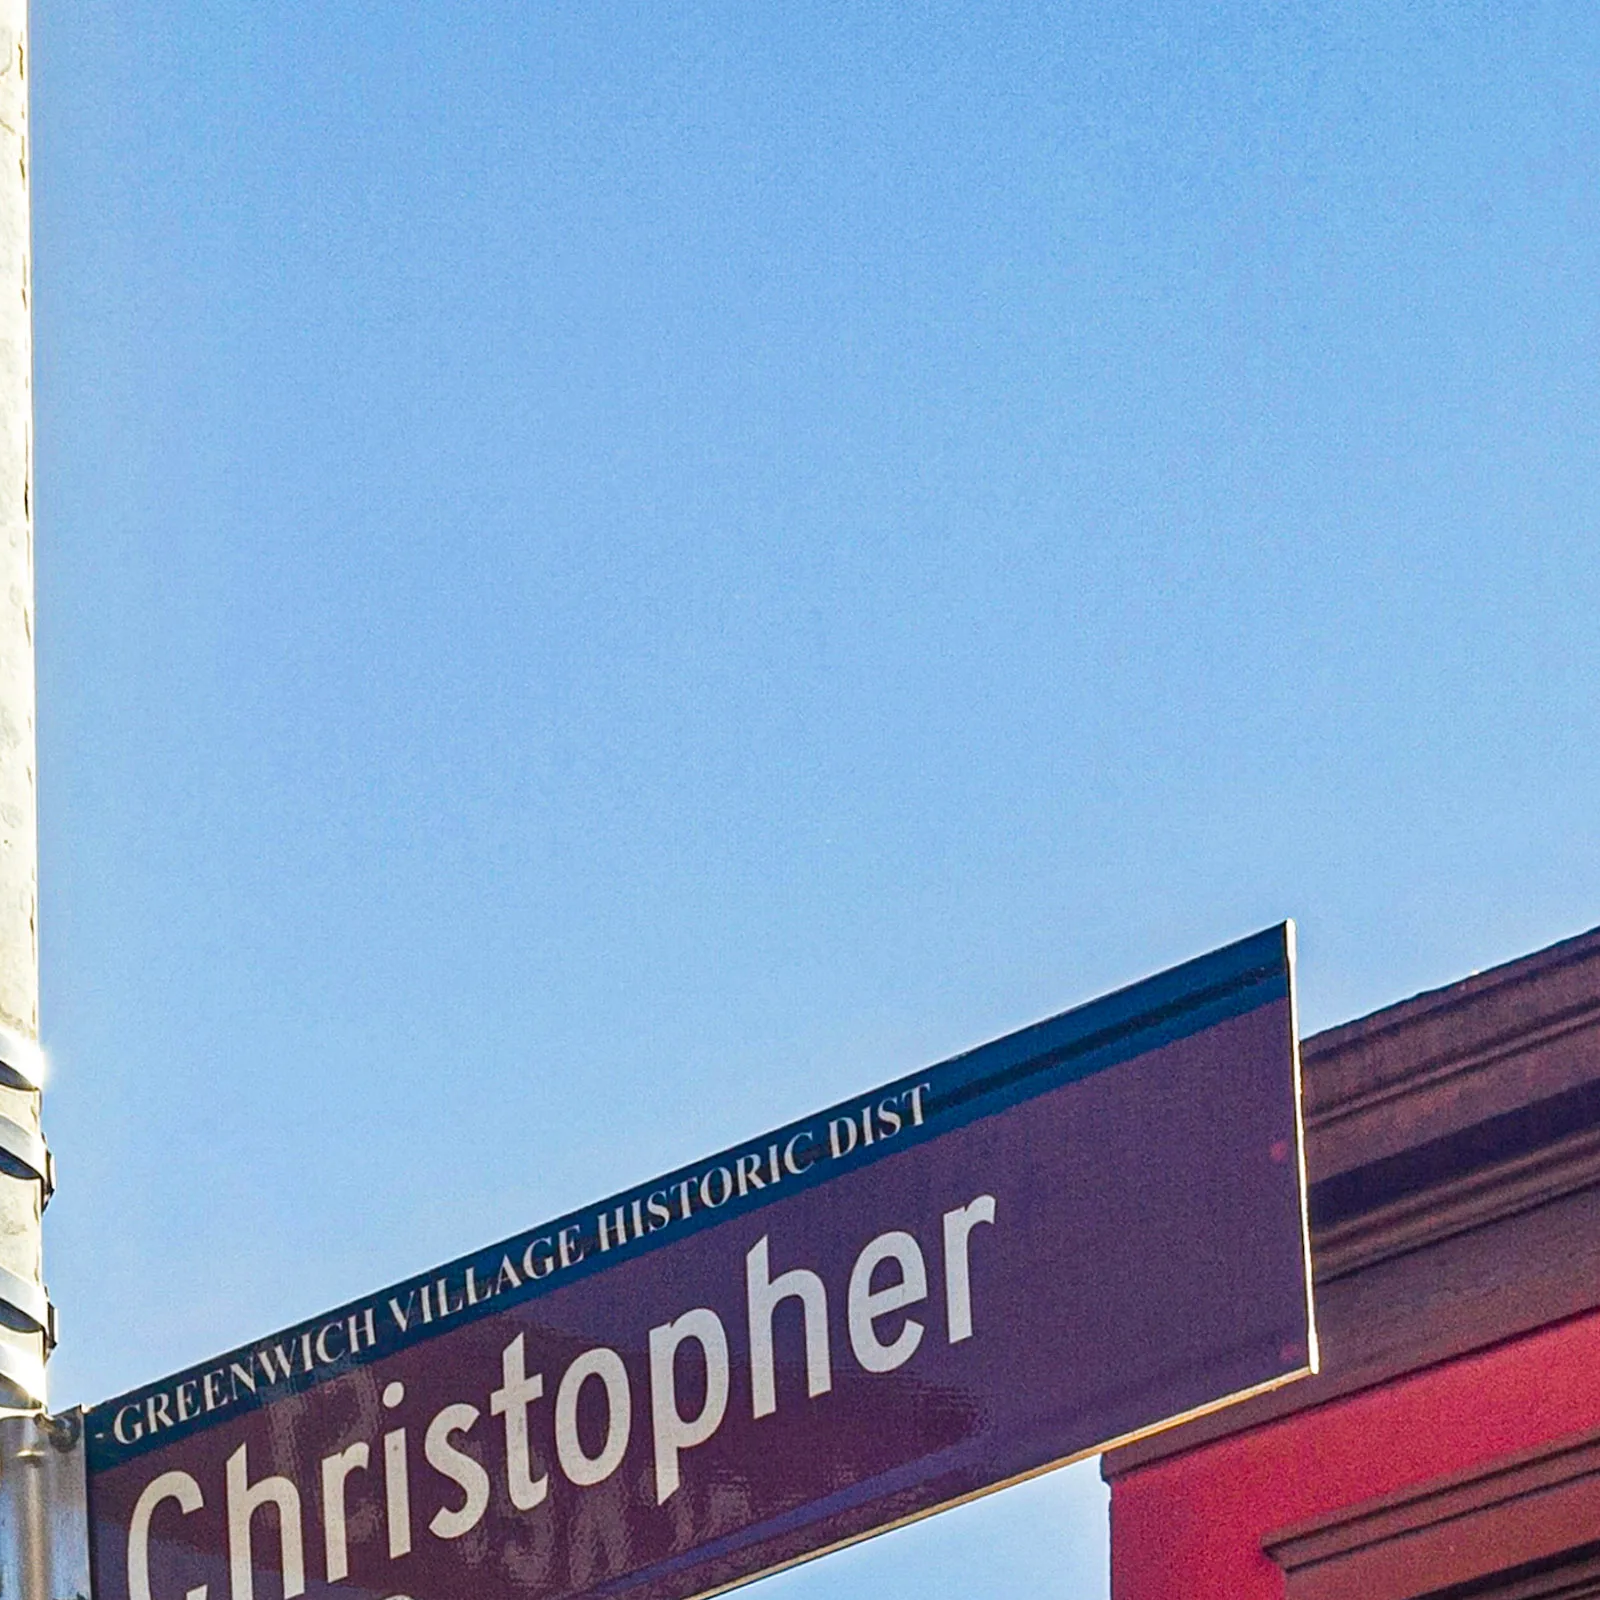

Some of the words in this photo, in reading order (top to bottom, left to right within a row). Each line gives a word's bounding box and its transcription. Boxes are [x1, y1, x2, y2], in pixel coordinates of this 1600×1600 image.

[113, 1307, 377, 1445] GREENWICH
[388, 1224, 585, 1333] VILLAGE
[598, 1132, 815, 1253] HISTORIC
[828, 1082, 931, 1160] DIST
